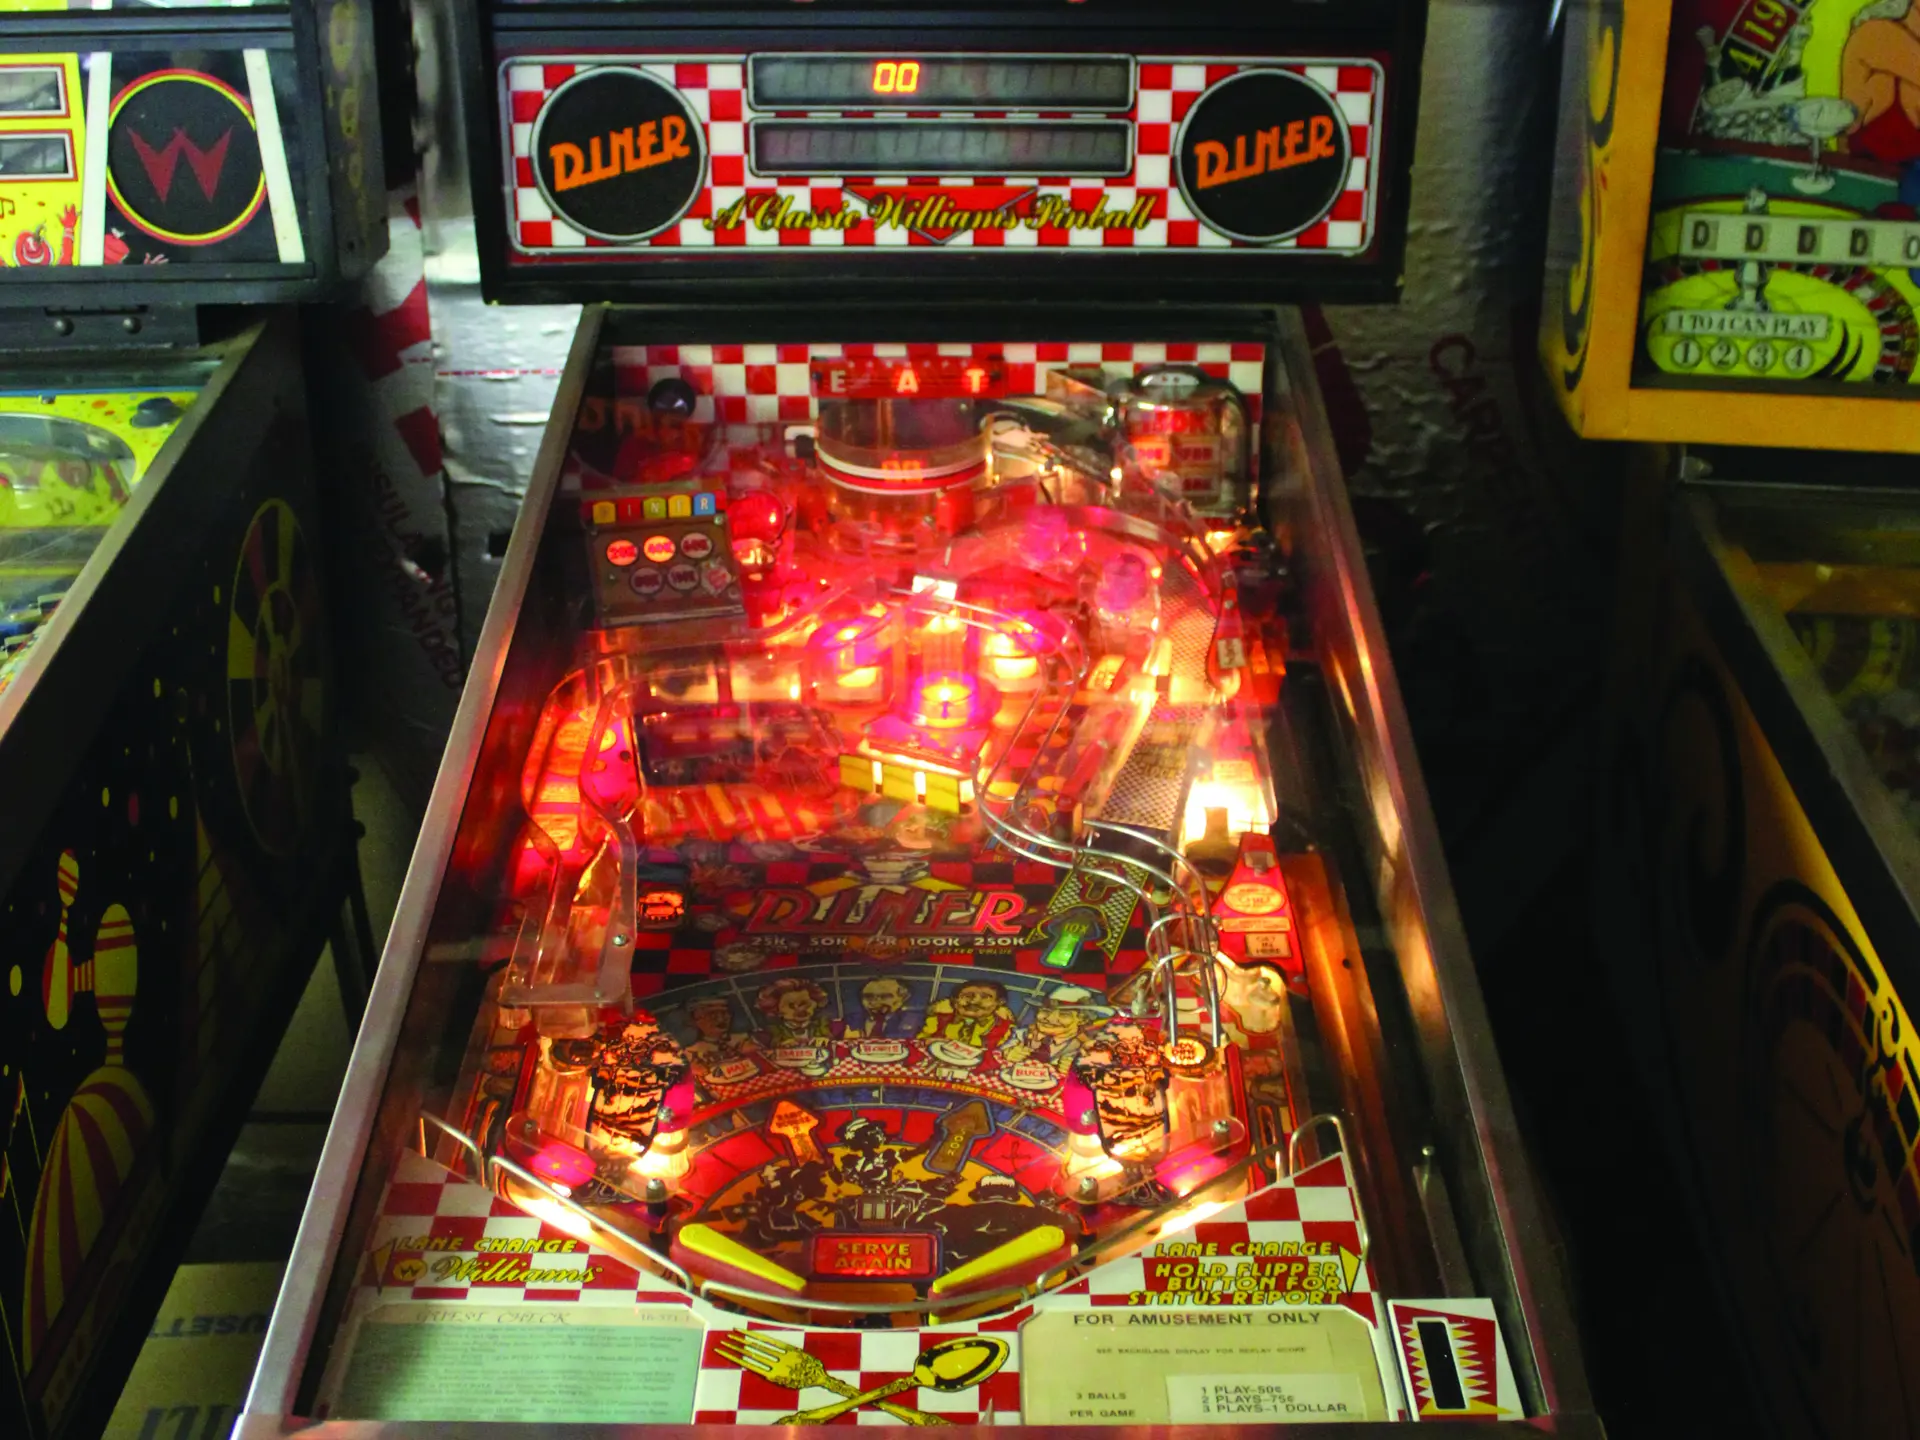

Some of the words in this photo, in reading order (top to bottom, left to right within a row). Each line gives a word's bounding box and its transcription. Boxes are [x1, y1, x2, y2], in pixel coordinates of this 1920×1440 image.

[872, 61, 920, 92] 00
[549, 113, 690, 192] DINER
[1193, 114, 1336, 190] DINER
[702, 193, 749, 231] A
[750, 193, 862, 231] Classic
[867, 192, 1020, 231] Williams
[1025, 192, 1157, 231] Pinball
[1690, 315, 1713, 330] TO
[1729, 316, 1766, 332] CAN
[1774, 318, 1820, 336] PLAY
[1682, 342, 1691, 363] 1
[1717, 343, 1732, 366] 2
[1754, 346, 1769, 369] 3
[1791, 348, 1803, 368] 4
[744, 887, 1027, 934] DINER
[751, 936, 787, 947] 25K
[809, 935, 848, 947] 50K
[910, 936, 961, 947] 100K
[973, 936, 1025, 947] 250K
[1016, 1068, 1047, 1078] BUCK
[398, 1236, 464, 1250] LANE
[474, 1237, 578, 1253] CHANGE
[837, 1242, 910, 1256] SERVE
[1154, 1242, 1219, 1257] LANE
[1230, 1241, 1333, 1257] CHANGE
[431, 1255, 597, 1283] Williams
[835, 1257, 912, 1270] AGAIN
[1155, 1263, 1228, 1277] HOLD
[1237, 1262, 1339, 1277] FLIPPER
[1166, 1277, 1276, 1291] BUTTON
[1286, 1277, 1342, 1291] FOR
[1128, 1291, 1222, 1305] STATUS
[1232, 1291, 1342, 1305] REPORT
[496, 1311, 572, 1326] CHECK
[1073, 1314, 1114, 1325] FOR
[1128, 1313, 1254, 1325] AMUSEMENT
[1267, 1312, 1321, 1324] ONLY
[1088, 1392, 1127, 1400] BALLS
[1069, 1410, 1094, 1418] PER
[1099, 1409, 1136, 1418] GAME
[1285, 1403, 1348, 1413] DOLLAR
